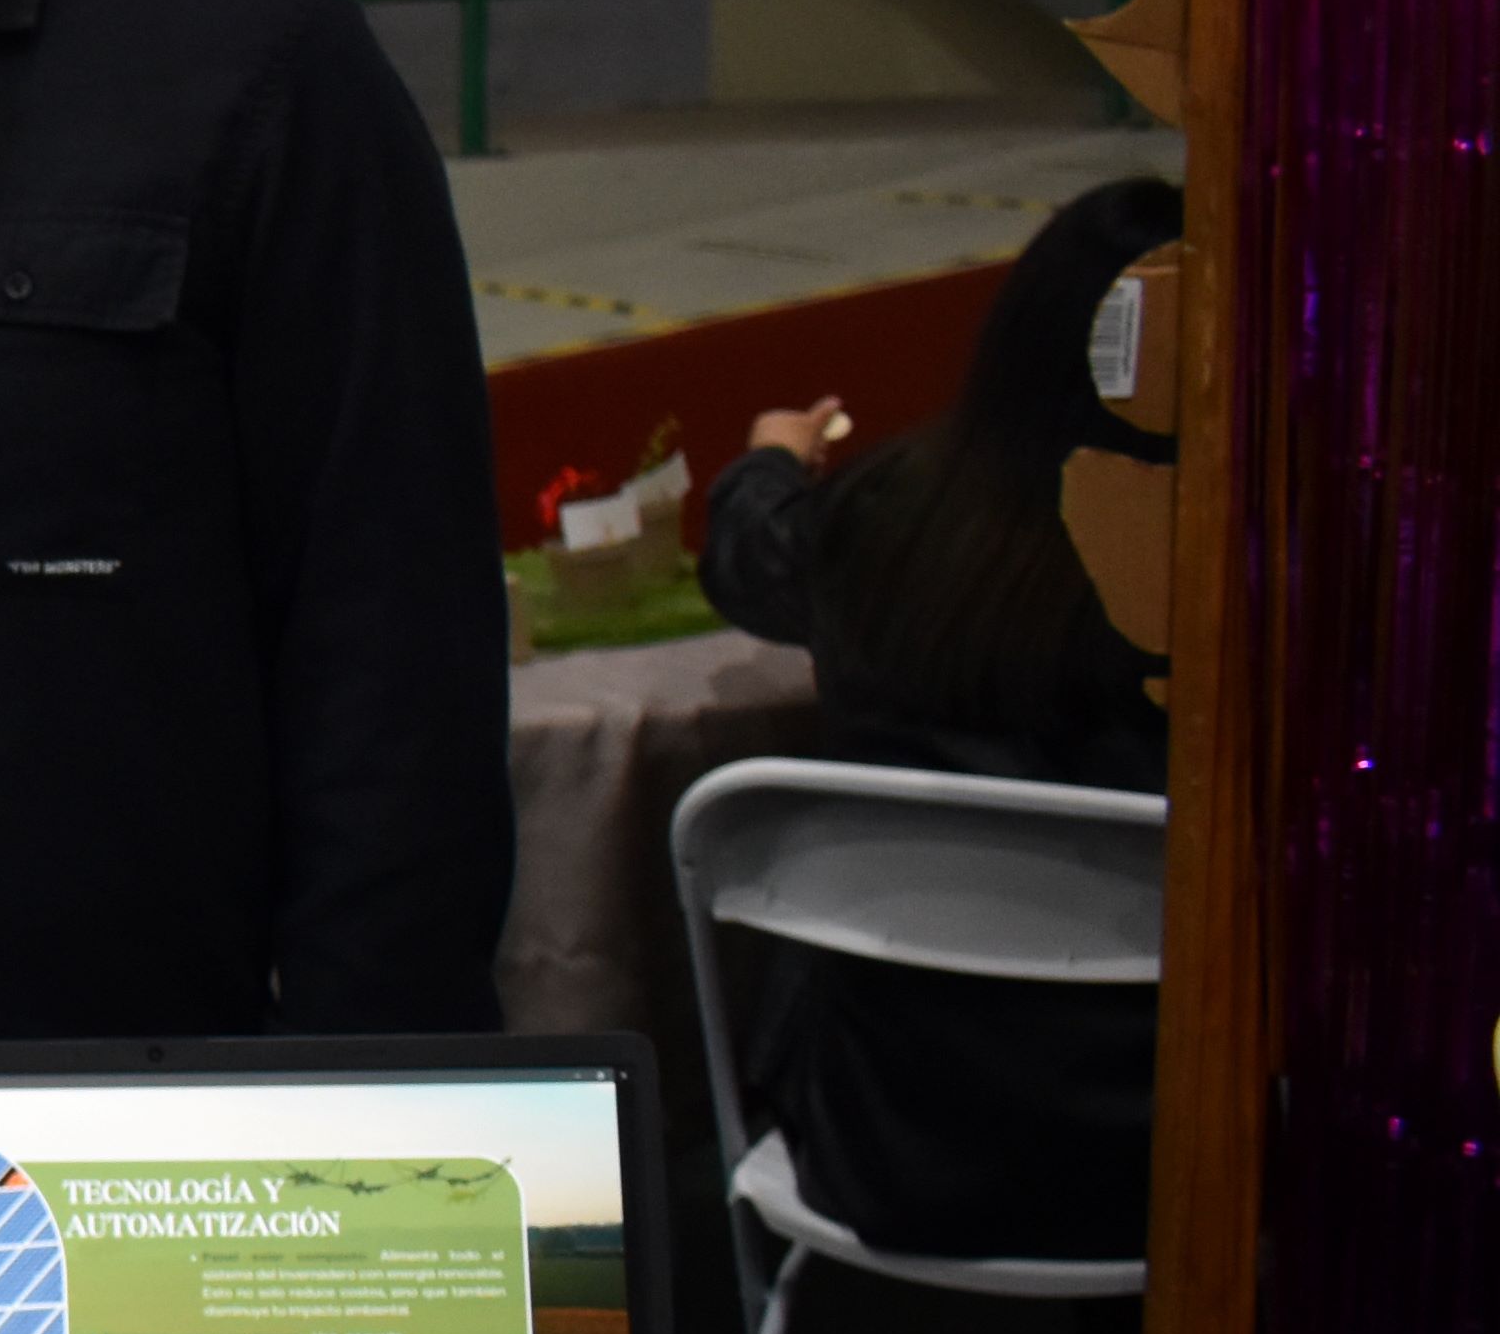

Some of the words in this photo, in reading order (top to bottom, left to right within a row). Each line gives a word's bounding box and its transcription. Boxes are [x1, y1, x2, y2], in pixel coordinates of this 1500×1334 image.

[63, 1173, 254, 1204] TECNOLOGÍA
[261, 1179, 283, 1203] Y
[66, 1207, 340, 1237] AUTOMATIZACIÓN
